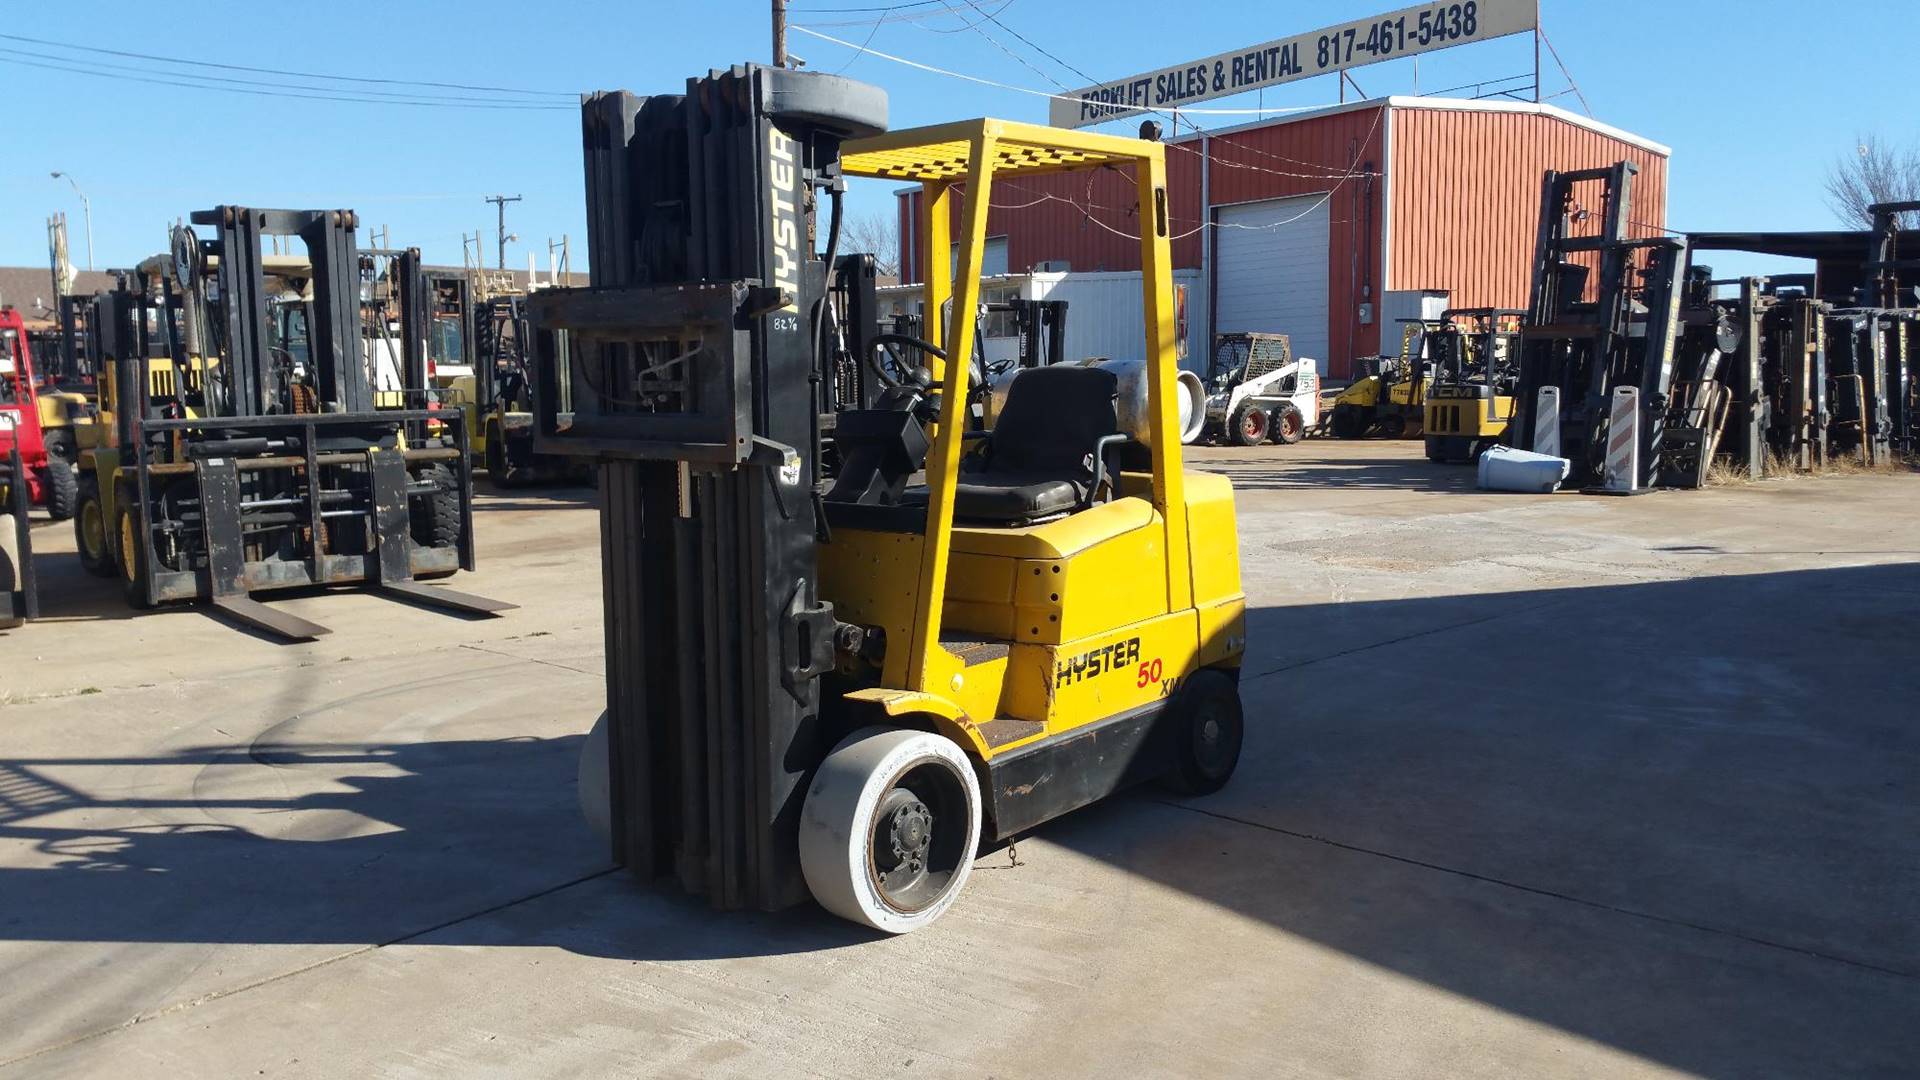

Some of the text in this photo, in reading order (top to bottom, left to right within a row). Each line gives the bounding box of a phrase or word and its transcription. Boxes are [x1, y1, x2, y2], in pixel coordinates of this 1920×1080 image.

[1080, 0, 1478, 121] FORKLIFT SALES & RENTAL 817-461-5438
[1056, 636, 1140, 689] HYSTER
[1136, 657, 1163, 689] 50
